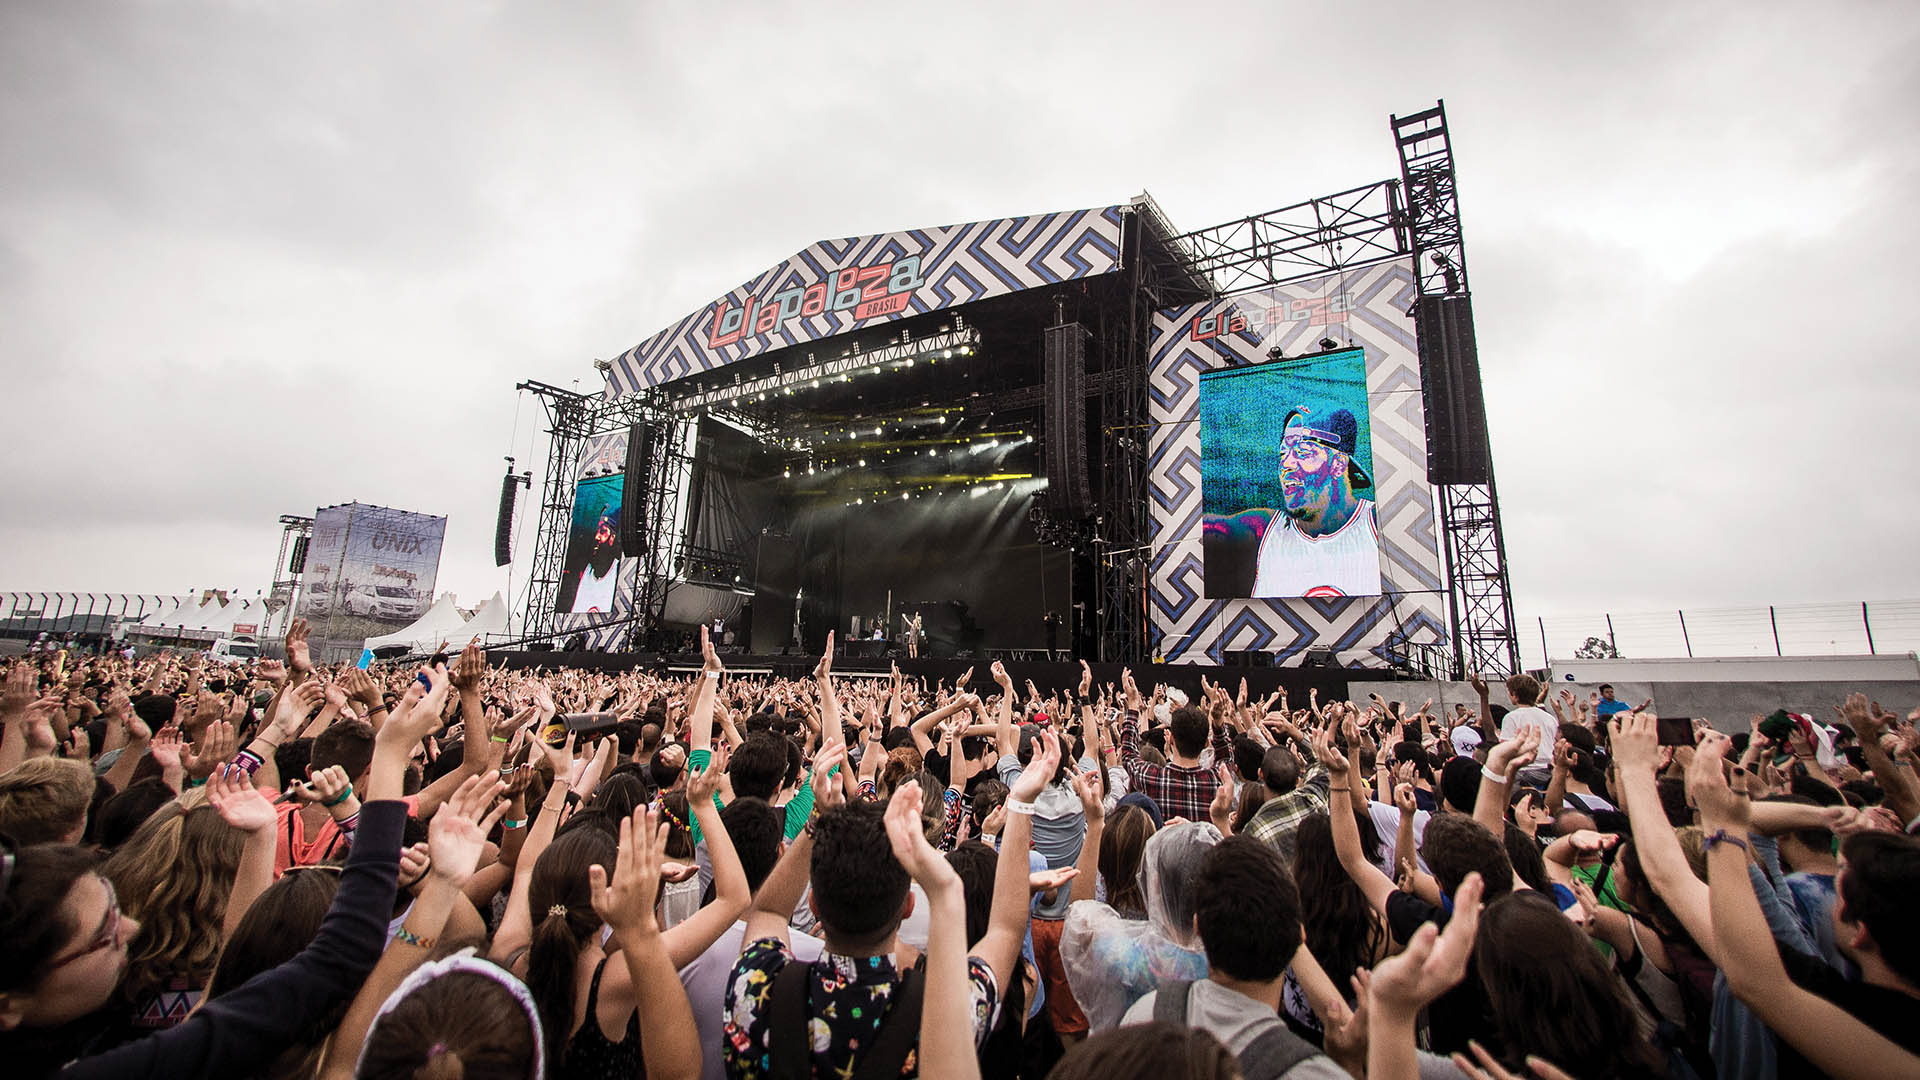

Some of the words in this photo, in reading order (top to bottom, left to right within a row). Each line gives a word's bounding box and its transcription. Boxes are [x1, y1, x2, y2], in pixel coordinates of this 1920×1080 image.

[709, 255, 924, 349] Lollapalooza
[866, 297, 898, 316] BRASIL
[372, 531, 426, 554] ONIX
